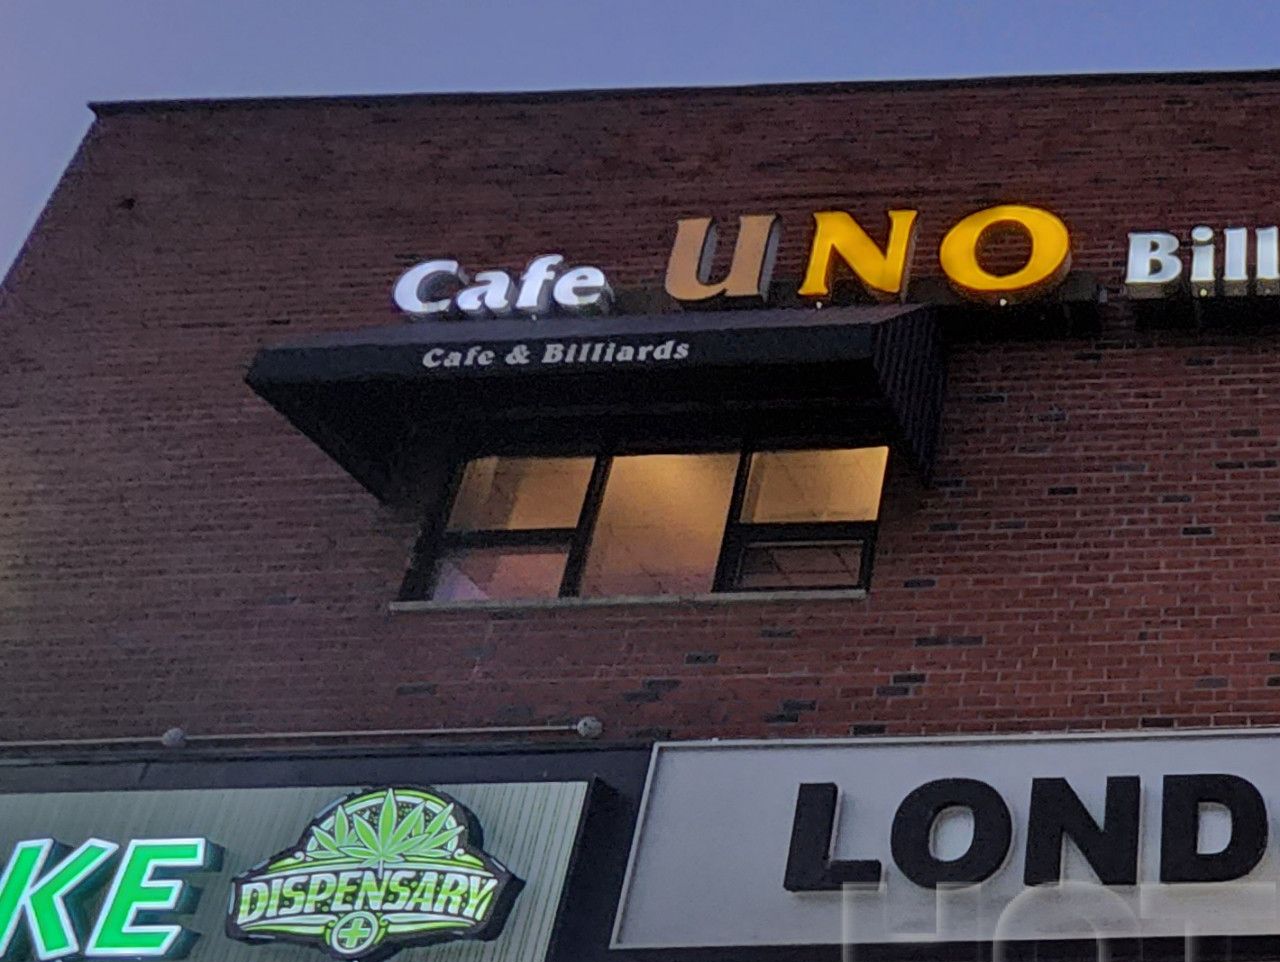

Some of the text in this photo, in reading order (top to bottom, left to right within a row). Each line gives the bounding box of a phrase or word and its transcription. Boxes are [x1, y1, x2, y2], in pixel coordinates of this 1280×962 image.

[393, 253, 607, 314] Cafe
[664, 205, 1070, 300] UNO
[422, 340, 690, 368] Cafe & Billiards
[236, 868, 500, 926] DISPENSARY
